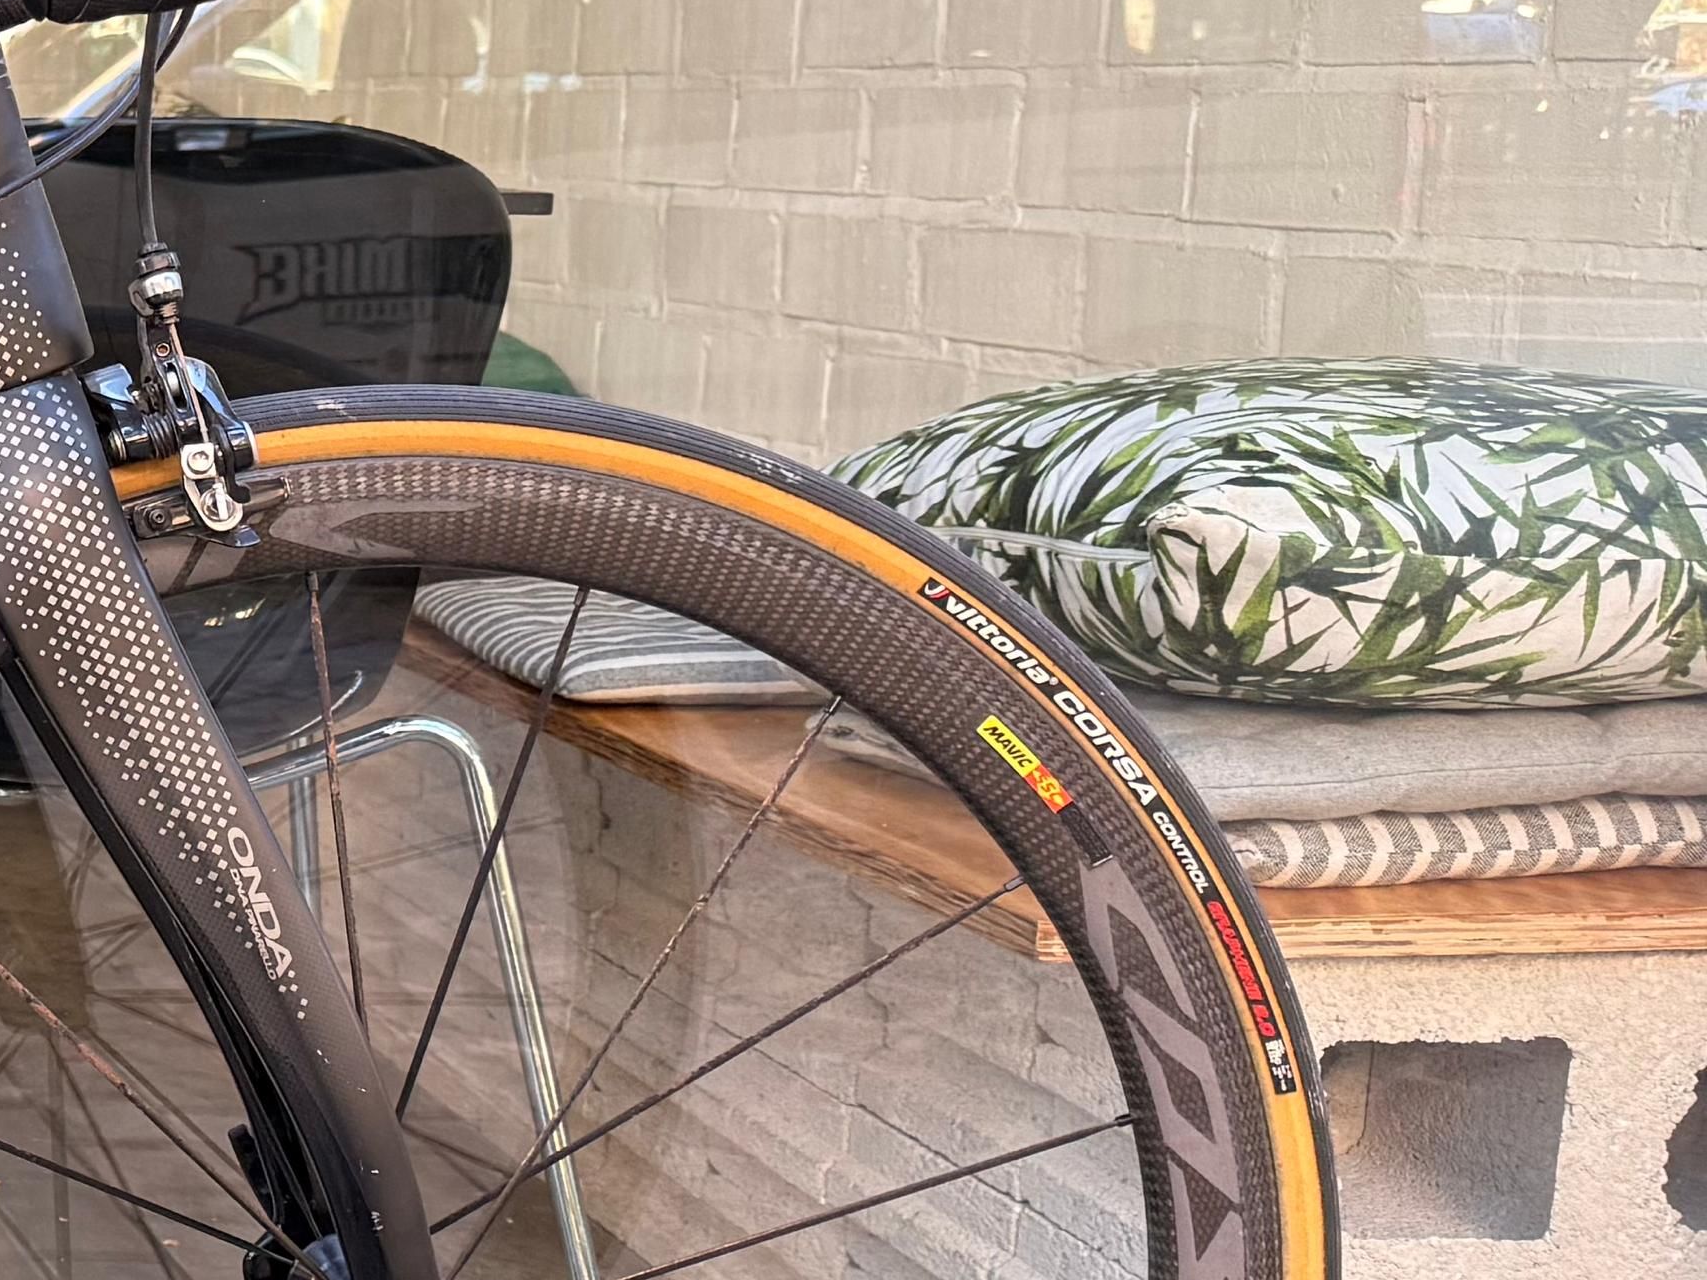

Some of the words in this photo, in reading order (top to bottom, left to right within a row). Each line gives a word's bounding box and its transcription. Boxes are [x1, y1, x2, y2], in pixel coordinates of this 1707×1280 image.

[983, 726, 1033, 769] MAVIC
[1053, 690, 1158, 806] CORSA
[1152, 811, 1212, 894] CONTROL
[227, 826, 293, 979] ONDA
[230, 868, 249, 908] DNA
